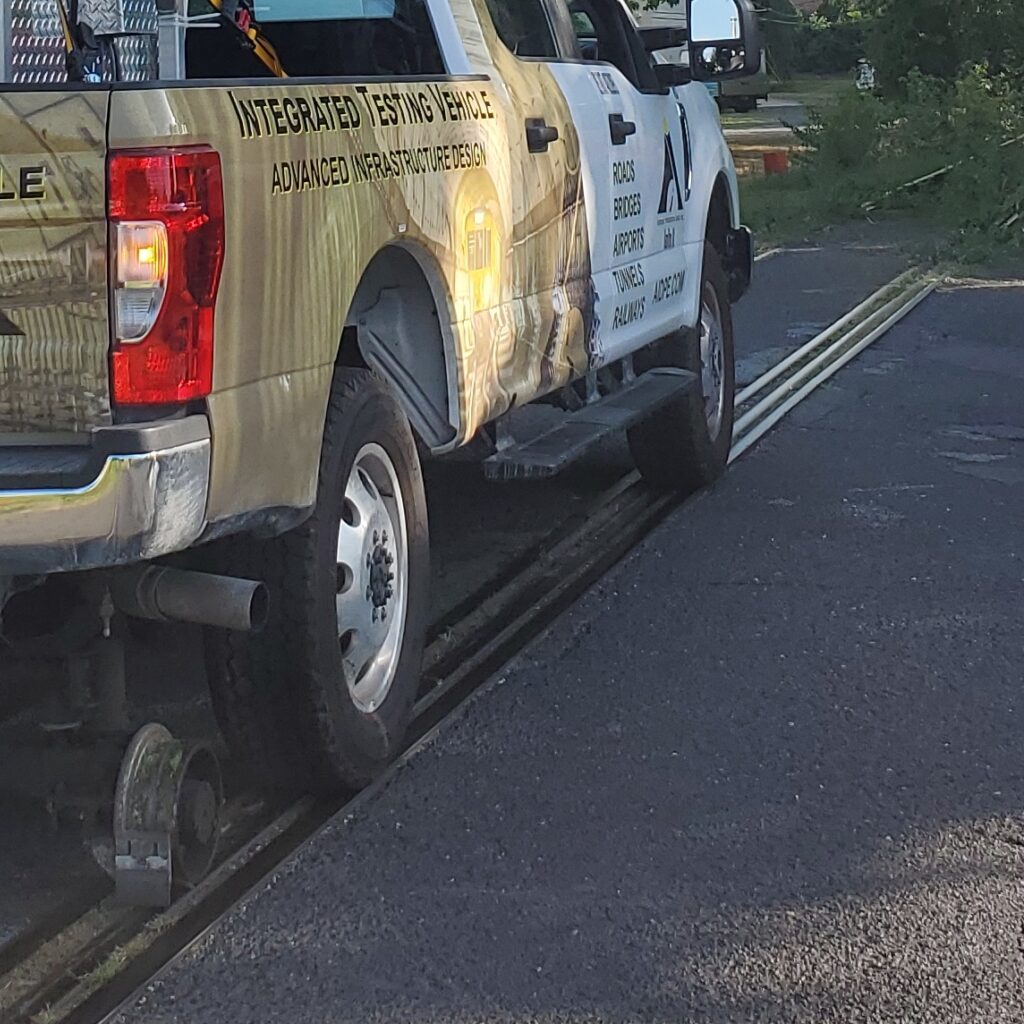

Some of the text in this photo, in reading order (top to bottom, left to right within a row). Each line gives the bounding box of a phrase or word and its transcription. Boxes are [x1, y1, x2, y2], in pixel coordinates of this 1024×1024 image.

[227, 84, 495, 138] INTEGRATED TESTING VEHICLE
[272, 142, 487, 195] ADVANCED INFRASTRUCTURE DESIGN
[612, 159, 636, 186] ROADS
[613, 192, 641, 221] BRIDGES
[613, 226, 645, 258] AIRPORTS
[612, 262, 645, 294] TUNNELS
[612, 296, 646, 330] RAILWAYS
